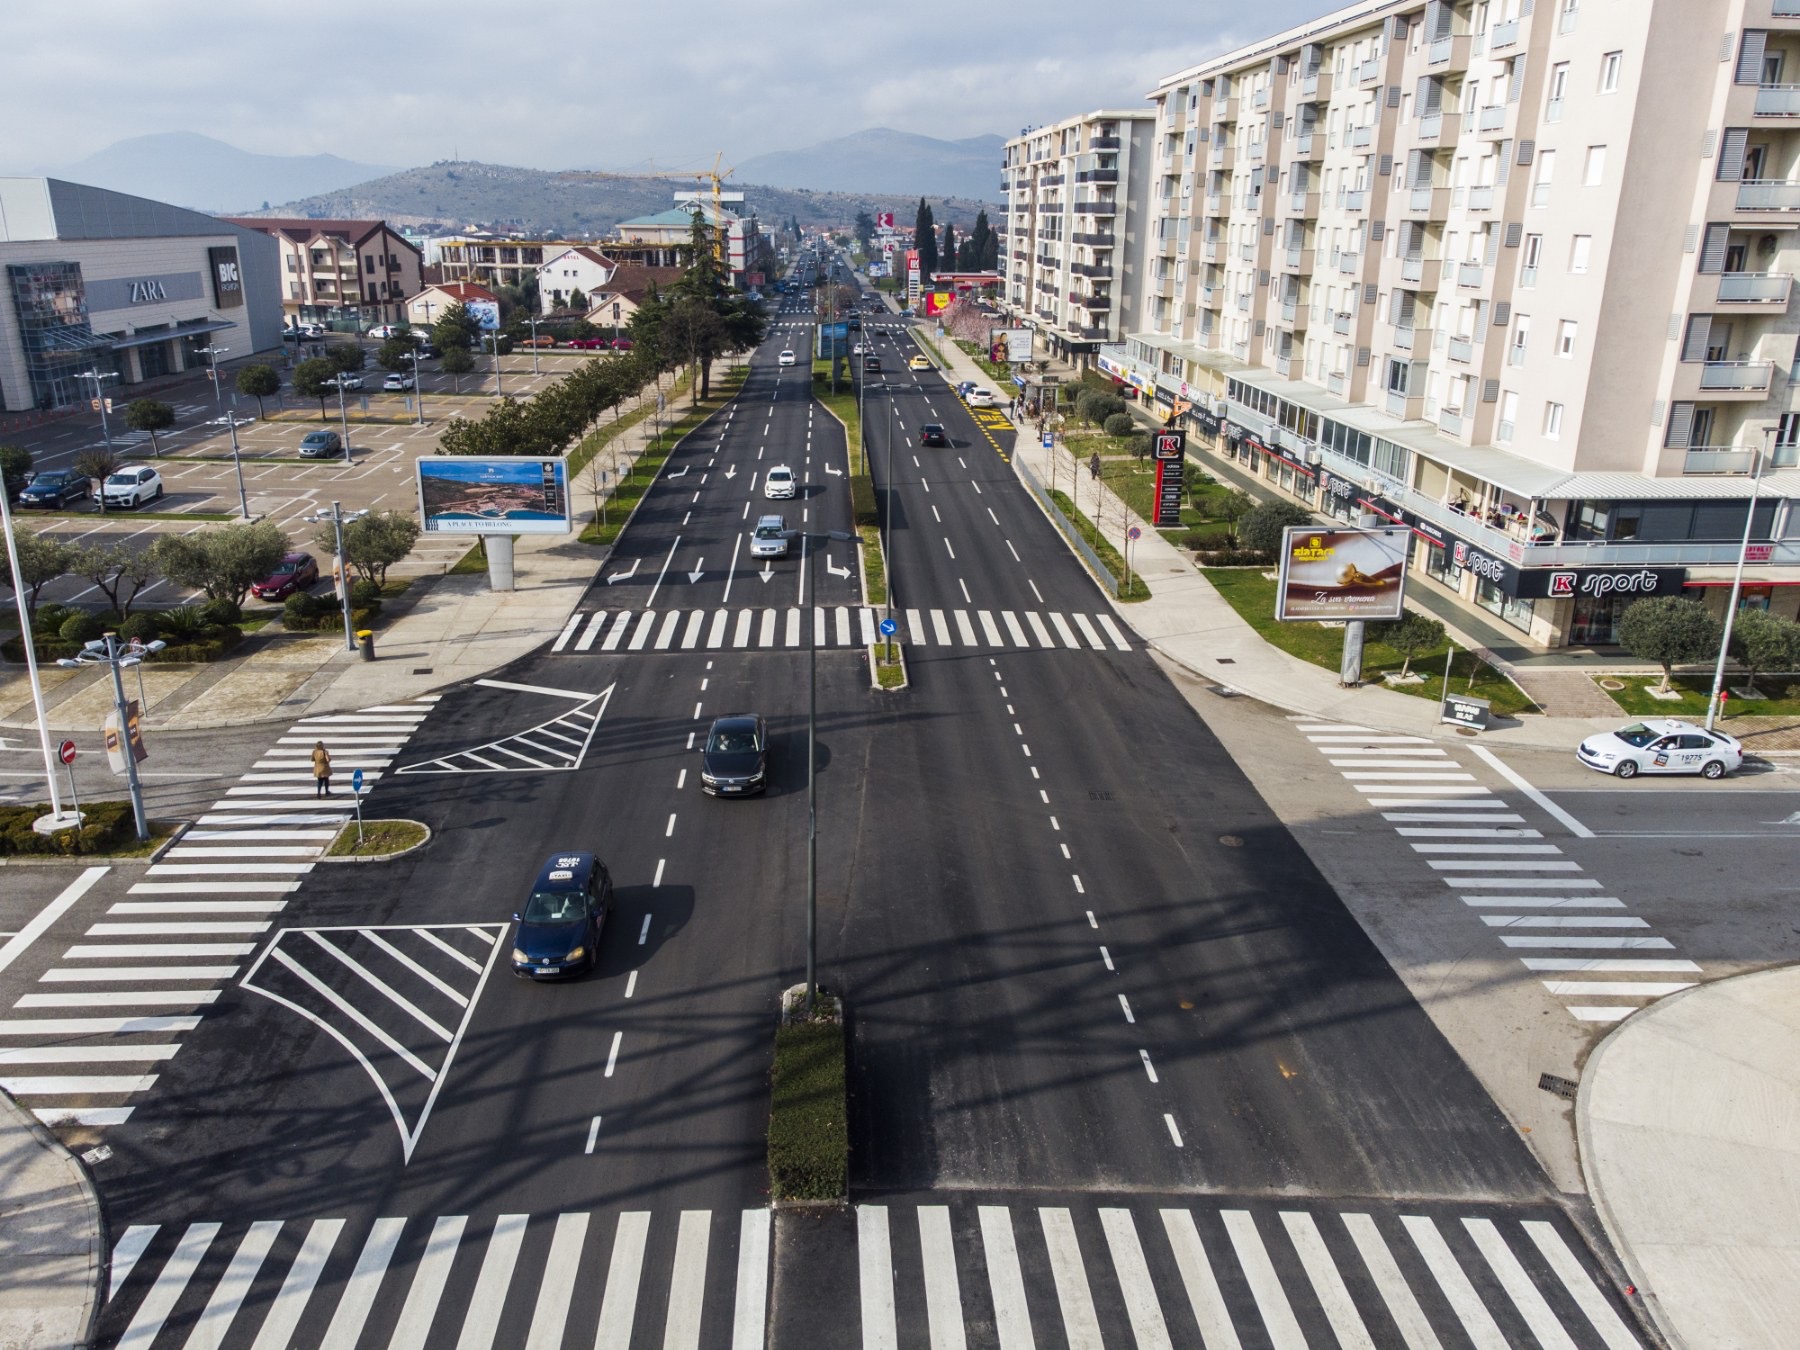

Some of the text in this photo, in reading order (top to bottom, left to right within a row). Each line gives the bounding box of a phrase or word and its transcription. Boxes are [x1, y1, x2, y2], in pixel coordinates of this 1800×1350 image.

[218, 262, 238, 282] BIG
[129, 280, 167, 303] ZARA
[1162, 438, 1176, 451] K
[1328, 477, 1352, 499] sport
[1455, 543, 1466, 560] K
[1467, 552, 1502, 582] sport
[1554, 570, 1658, 597] K sport
[1310, 591, 1328, 605] Za
